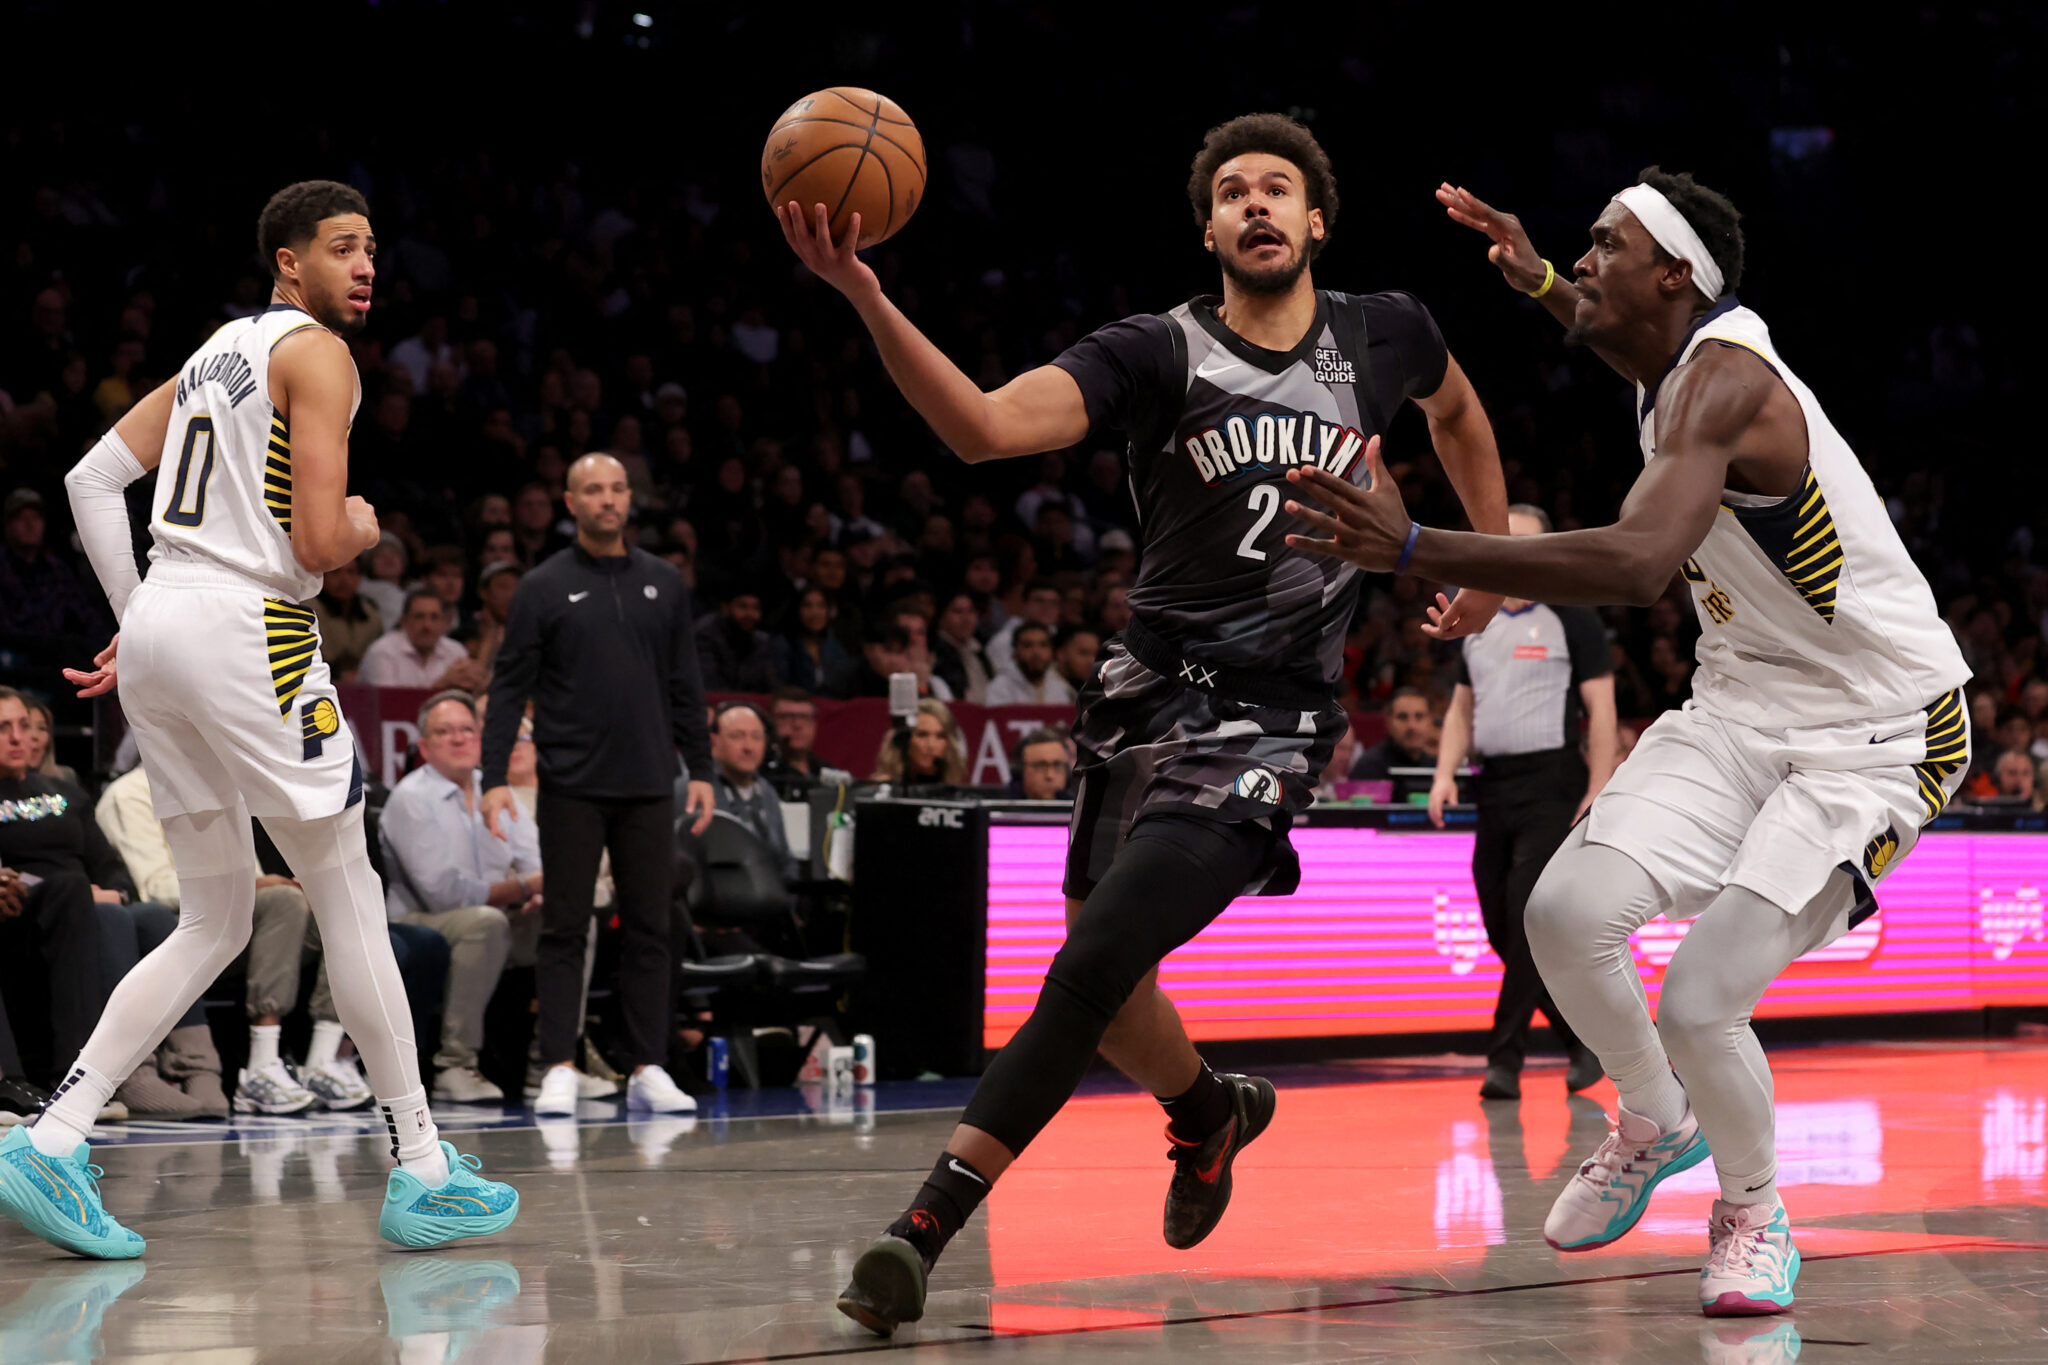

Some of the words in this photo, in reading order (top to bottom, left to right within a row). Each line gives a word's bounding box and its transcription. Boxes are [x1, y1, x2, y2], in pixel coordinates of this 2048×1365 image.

[1315, 348, 1338, 361] GET
[1315, 359, 1353, 372] YOUR
[177, 351, 257, 409] HALIBURTON
[1315, 370, 1357, 383] GUIDE
[1185, 414, 1363, 484] BROOKLYN
[162, 415, 215, 530] 0
[1236, 484, 1280, 562] 2
[918, 806, 964, 829] anc
